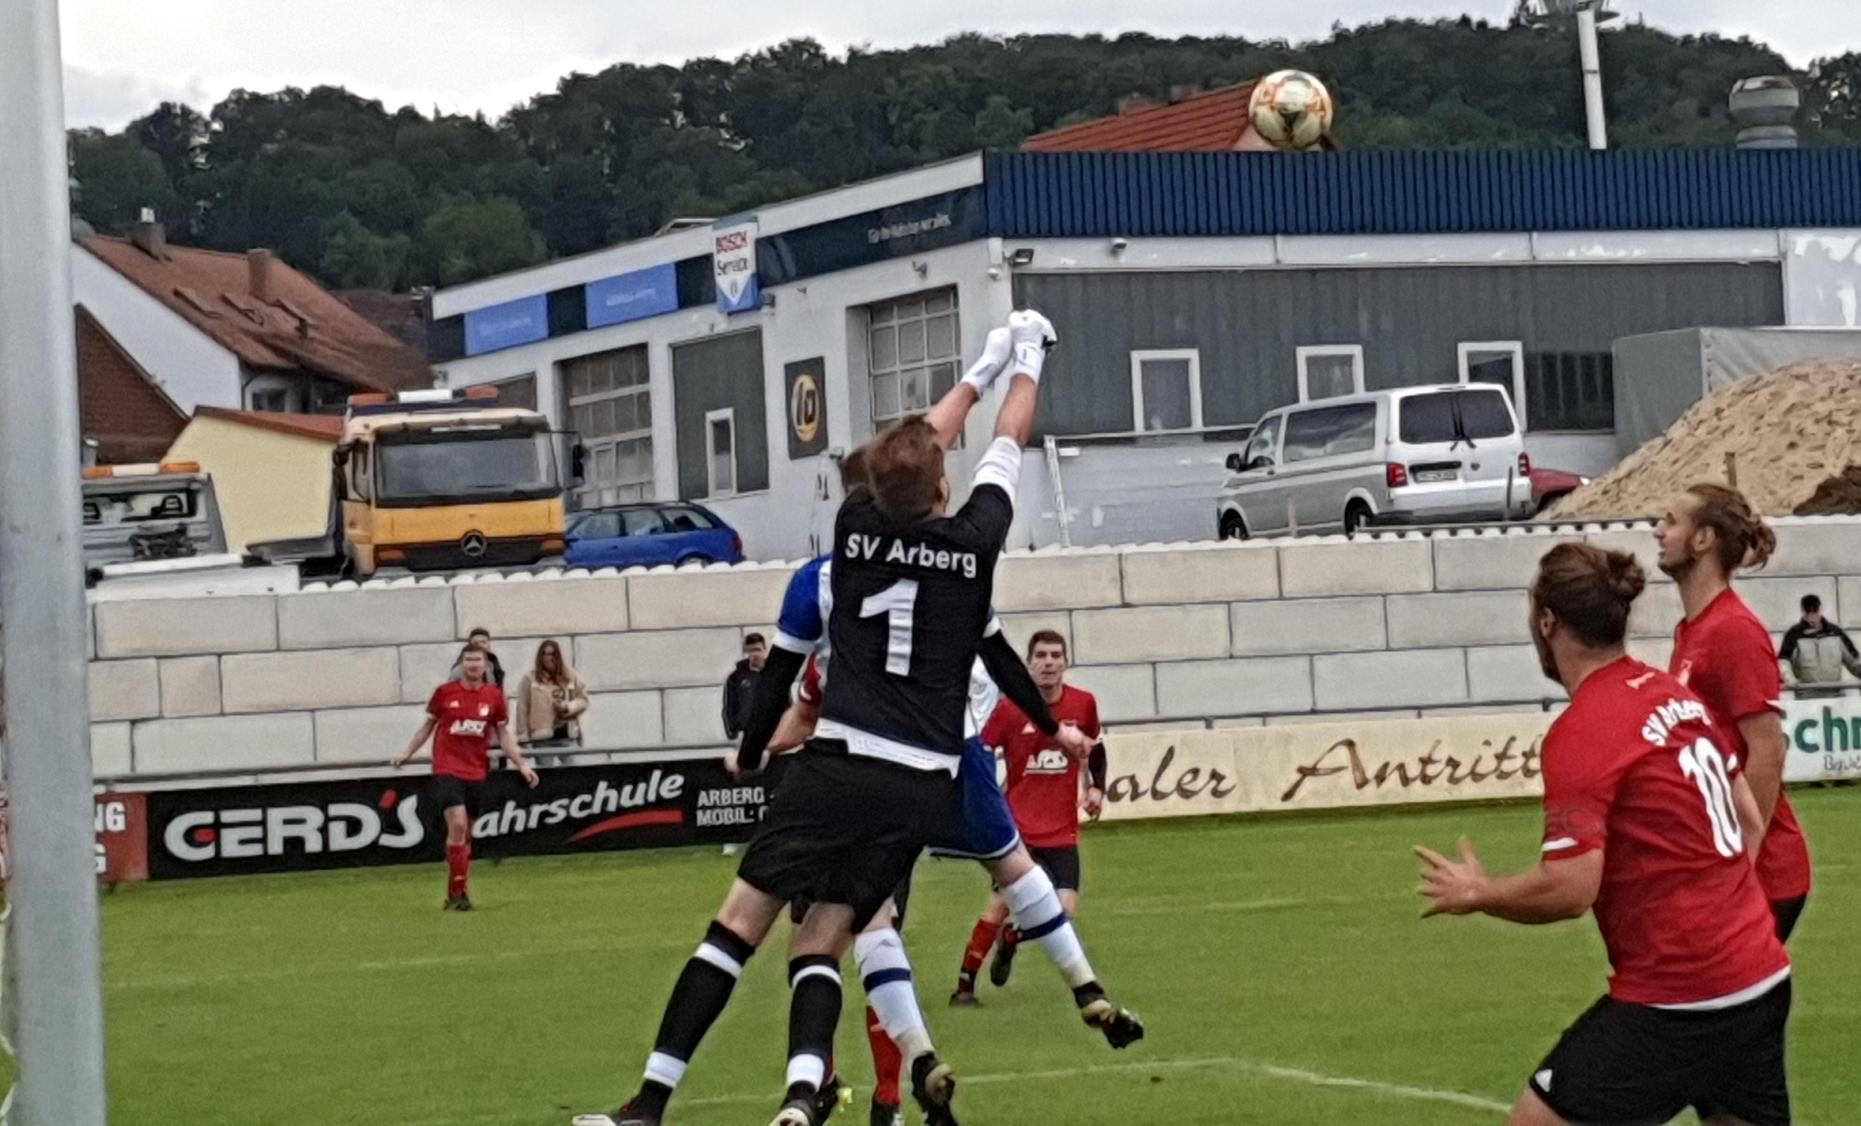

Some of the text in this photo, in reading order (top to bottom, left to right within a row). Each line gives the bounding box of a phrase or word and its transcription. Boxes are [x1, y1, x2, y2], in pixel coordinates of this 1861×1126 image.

[845, 533, 978, 580] SV Arberg
[859, 578, 919, 676] 1
[472, 770, 686, 839] ahrschule
[1106, 745, 1237, 802] aler
[1678, 736, 1744, 857] 10
[164, 790, 426, 861] GERD'S
